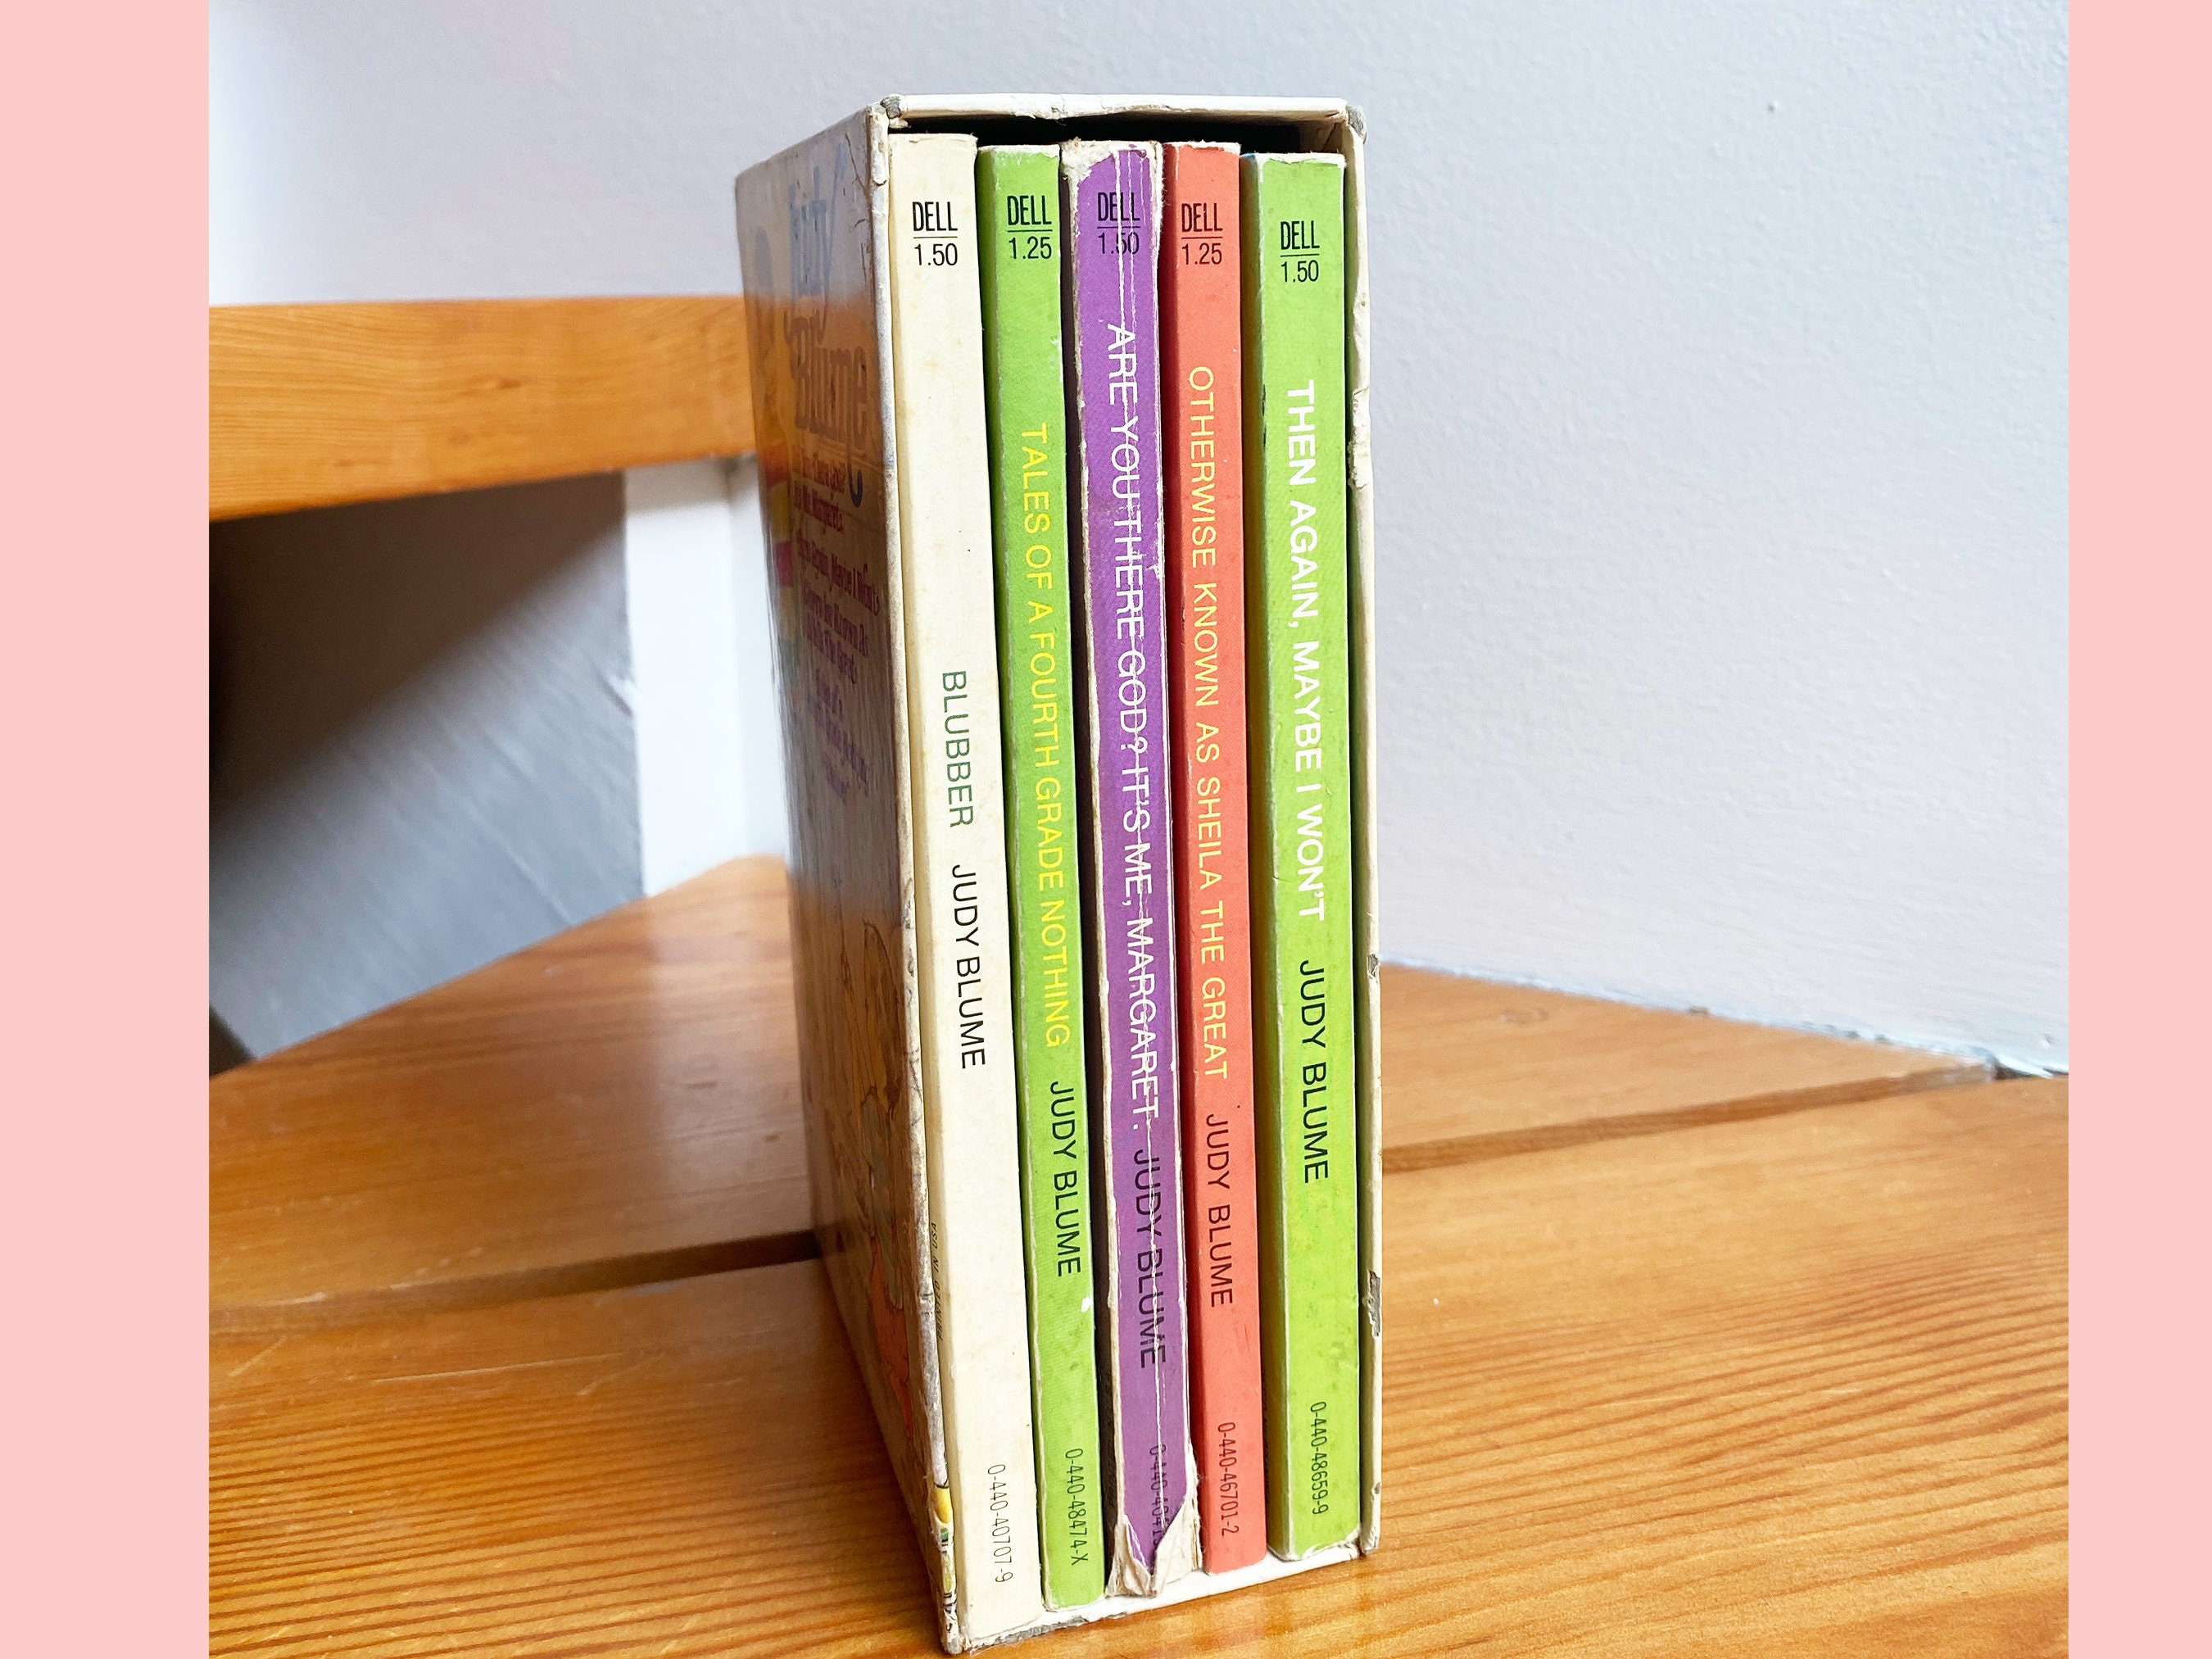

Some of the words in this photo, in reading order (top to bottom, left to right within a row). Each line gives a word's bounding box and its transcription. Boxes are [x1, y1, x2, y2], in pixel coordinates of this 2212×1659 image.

[912, 202, 959, 232] DELL
[913, 243, 959, 266] 1.50
[1007, 195, 1053, 227] DELL
[1008, 237, 1053, 260] 1.25
[1098, 192, 1140, 222] DELL
[1098, 232, 1140, 256] 1.50
[1181, 203, 1223, 233] DELL
[1181, 243, 1223, 265] 1.25
[1280, 220, 1320, 250] DELL
[1281, 260, 1320, 283] 1.50
[1108, 324, 1138, 406] ARE
[1021, 422, 1051, 534] TALES
[1110, 415, 1140, 499] YOU
[1188, 365, 1217, 569] OTHERWISE
[1287, 379, 1316, 487] THEN
[1026, 544, 1053, 590] OF
[1113, 510, 1145, 641] THERE
[1288, 499, 1319, 628] AGAIN,
[1028, 601, 1053, 623] A
[1193, 582, 1219, 708] KNOWN
[1030, 632, 1060, 768] FOURTH
[1117, 650, 1148, 754] GOD?
[1194, 721, 1220, 764] AS
[1292, 641, 1321, 773] MAYBE
[942, 670, 974, 828] BLUBBER
[1295, 783, 1321, 793] I
[1036, 776, 1063, 890] GRADE
[1124, 842, 1153, 907] ME,
[1196, 776, 1222, 891] SHEILA
[1295, 803, 1325, 922] WON'T
[952, 863, 981, 947] JUDY
[1199, 904, 1224, 963] THE
[957, 956, 986, 1069] BLUME
[1040, 900, 1070, 1047] NOTHING
[1299, 960, 1326, 1049] JUDY
[1126, 917, 1160, 1131] MARGARET.
[1201, 977, 1227, 1080] GREAT
[1050, 1081, 1077, 1160] JUDY
[1205, 1113, 1231, 1190] JUDY
[1302, 1063, 1330, 1185] BLUME
[1054, 1171, 1081, 1278] BLUME
[1133, 1149, 1162, 1237] JUDY
[932, 1256, 939, 1272] IN
[1208, 1203, 1233, 1309] BLUME
[935, 1280, 944, 1342] PRINTED
[1138, 1248, 1166, 1369] BLUME
[1217, 1422, 1240, 1537] 0-440-46701-2
[1310, 1402, 1329, 1515] 0-440-48659-9
[987, 1464, 1013, 1583] 0-440-40707-9
[1065, 1448, 1089, 1566] 0-440-48474-X
